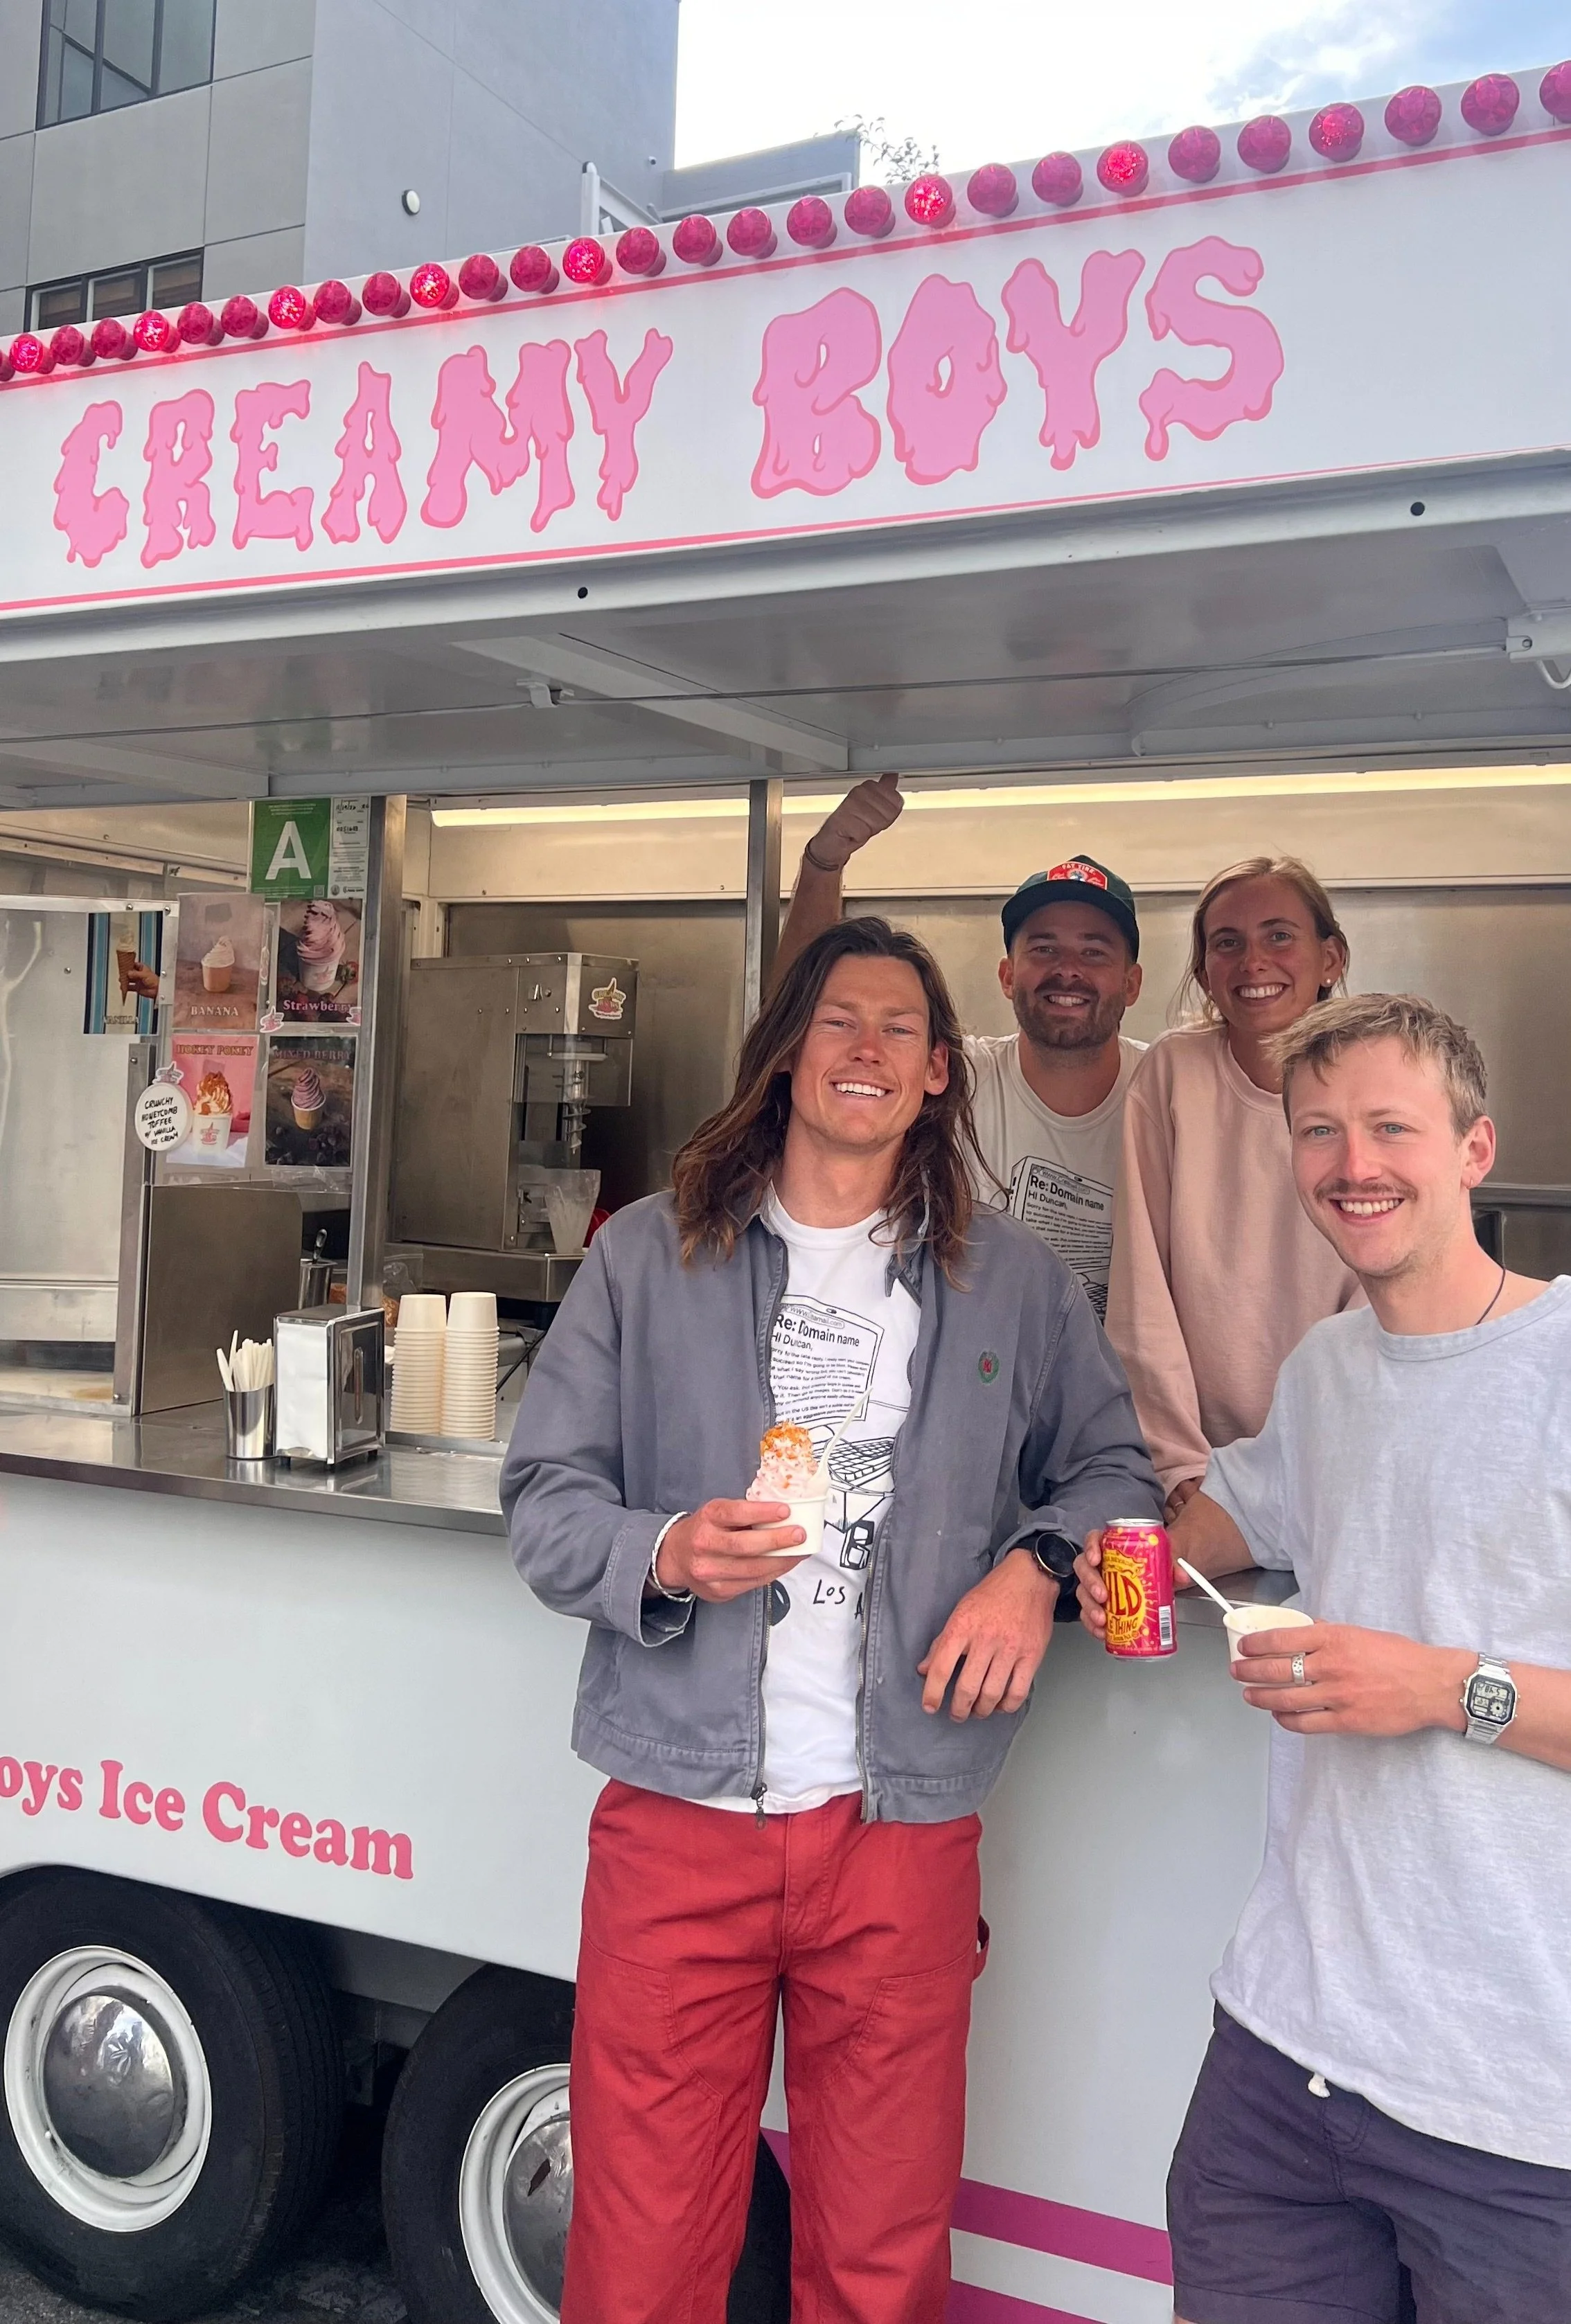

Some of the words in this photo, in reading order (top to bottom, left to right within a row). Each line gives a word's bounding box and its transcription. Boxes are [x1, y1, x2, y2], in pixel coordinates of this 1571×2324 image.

[53, 328, 673, 569] CREAMY
[750, 235, 1284, 499] BOYS
[265, 821, 312, 879] A
[191, 1005, 239, 1016] BANANA
[103, 1015, 139, 1025] VANILLA
[177, 1044, 215, 1055] HOKEY
[217, 1045, 254, 1055] POKEY
[274, 1049, 310, 1059] MIXED
[314, 1050, 351, 1060] BERRY
[145, 1097, 173, 1109] CRUNCHY
[148, 1116, 172, 1129] TOFFEE
[1030, 1175, 1049, 1191] Re:
[1050, 1182, 1083, 1205] Domain
[1085, 1199, 1104, 1210] name
[775, 1313, 797, 1332] Re:
[798, 1320, 835, 1343] Domain
[837, 1337, 860, 1348] name
[99, 1760, 185, 1831] Ice
[202, 1781, 414, 1879] Cream
